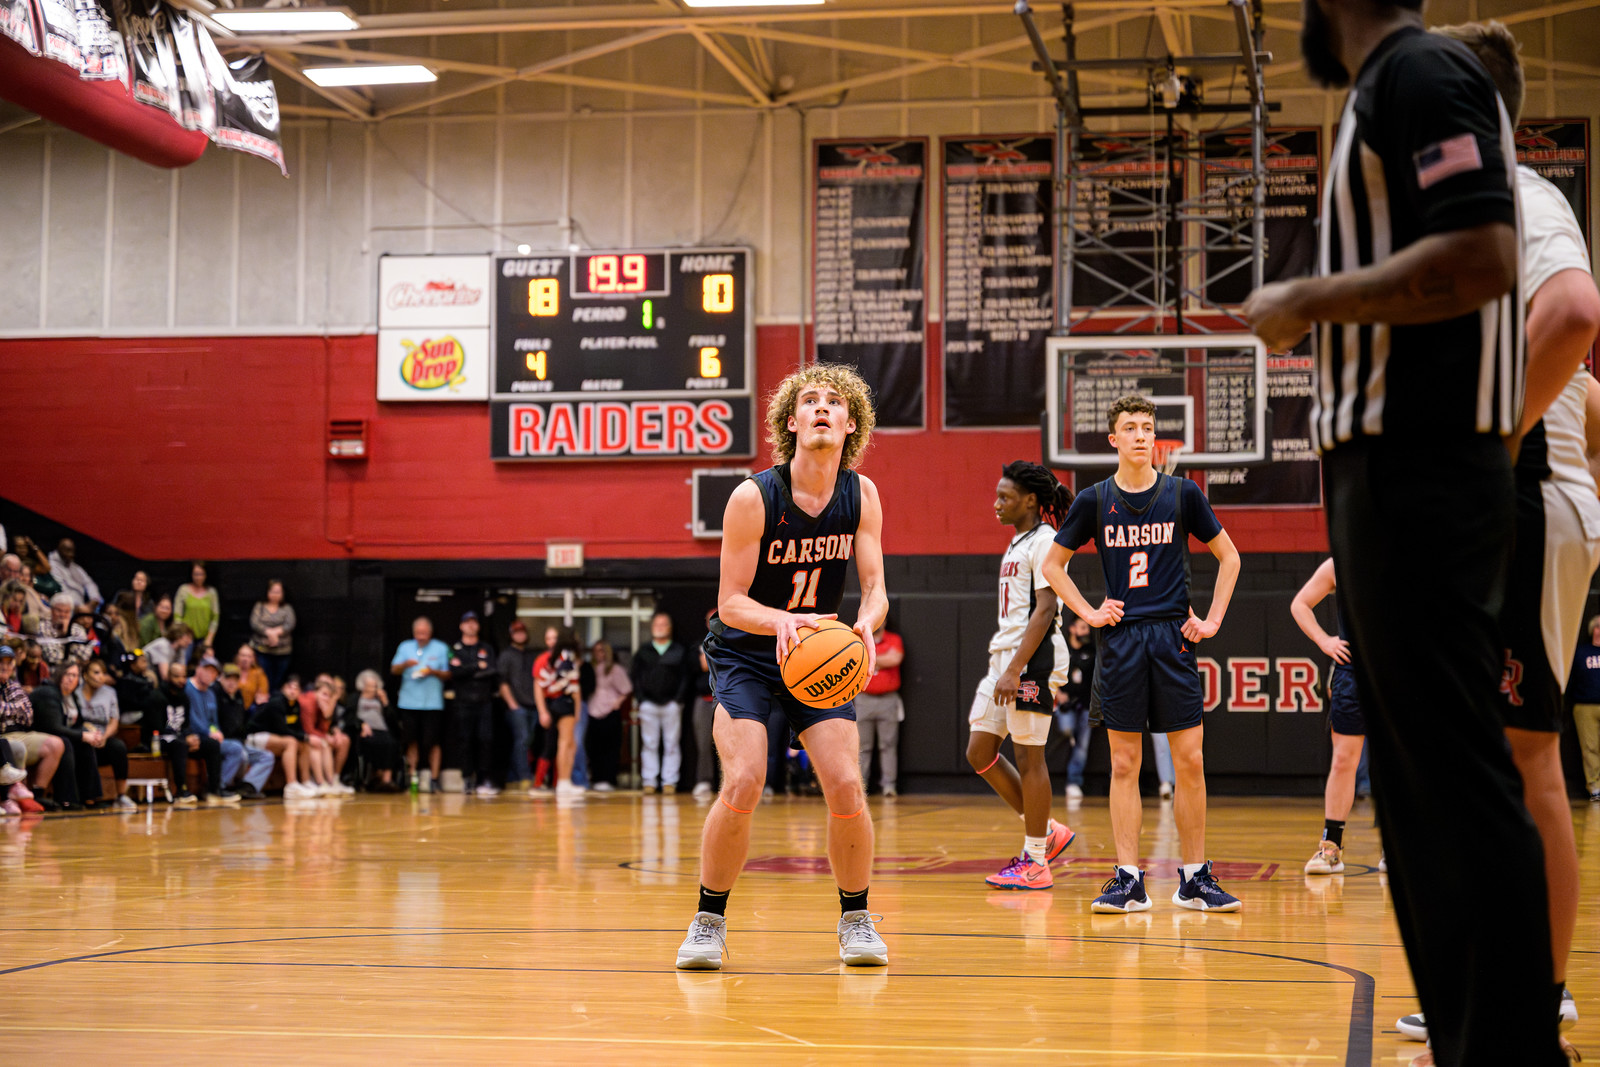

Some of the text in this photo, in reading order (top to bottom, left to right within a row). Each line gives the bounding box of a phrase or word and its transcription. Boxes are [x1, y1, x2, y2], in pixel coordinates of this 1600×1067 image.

[502, 258, 564, 278] GUEST
[588, 254, 648, 293] 19.9
[680, 255, 735, 273] HOME
[572, 306, 628, 323] PERIOD
[412, 338, 455, 361] Sun
[700, 347, 721, 378] 6
[410, 358, 458, 386] Drop
[526, 350, 547, 380] 4
[508, 400, 734, 457] RAIDERS
[767, 534, 854, 564] CARSON
[1104, 522, 1175, 547] CARSON
[1129, 551, 1149, 588] 2
[787, 568, 822, 611] 11
[803, 658, 857, 697] Wilson
[1197, 657, 1323, 713] DER
